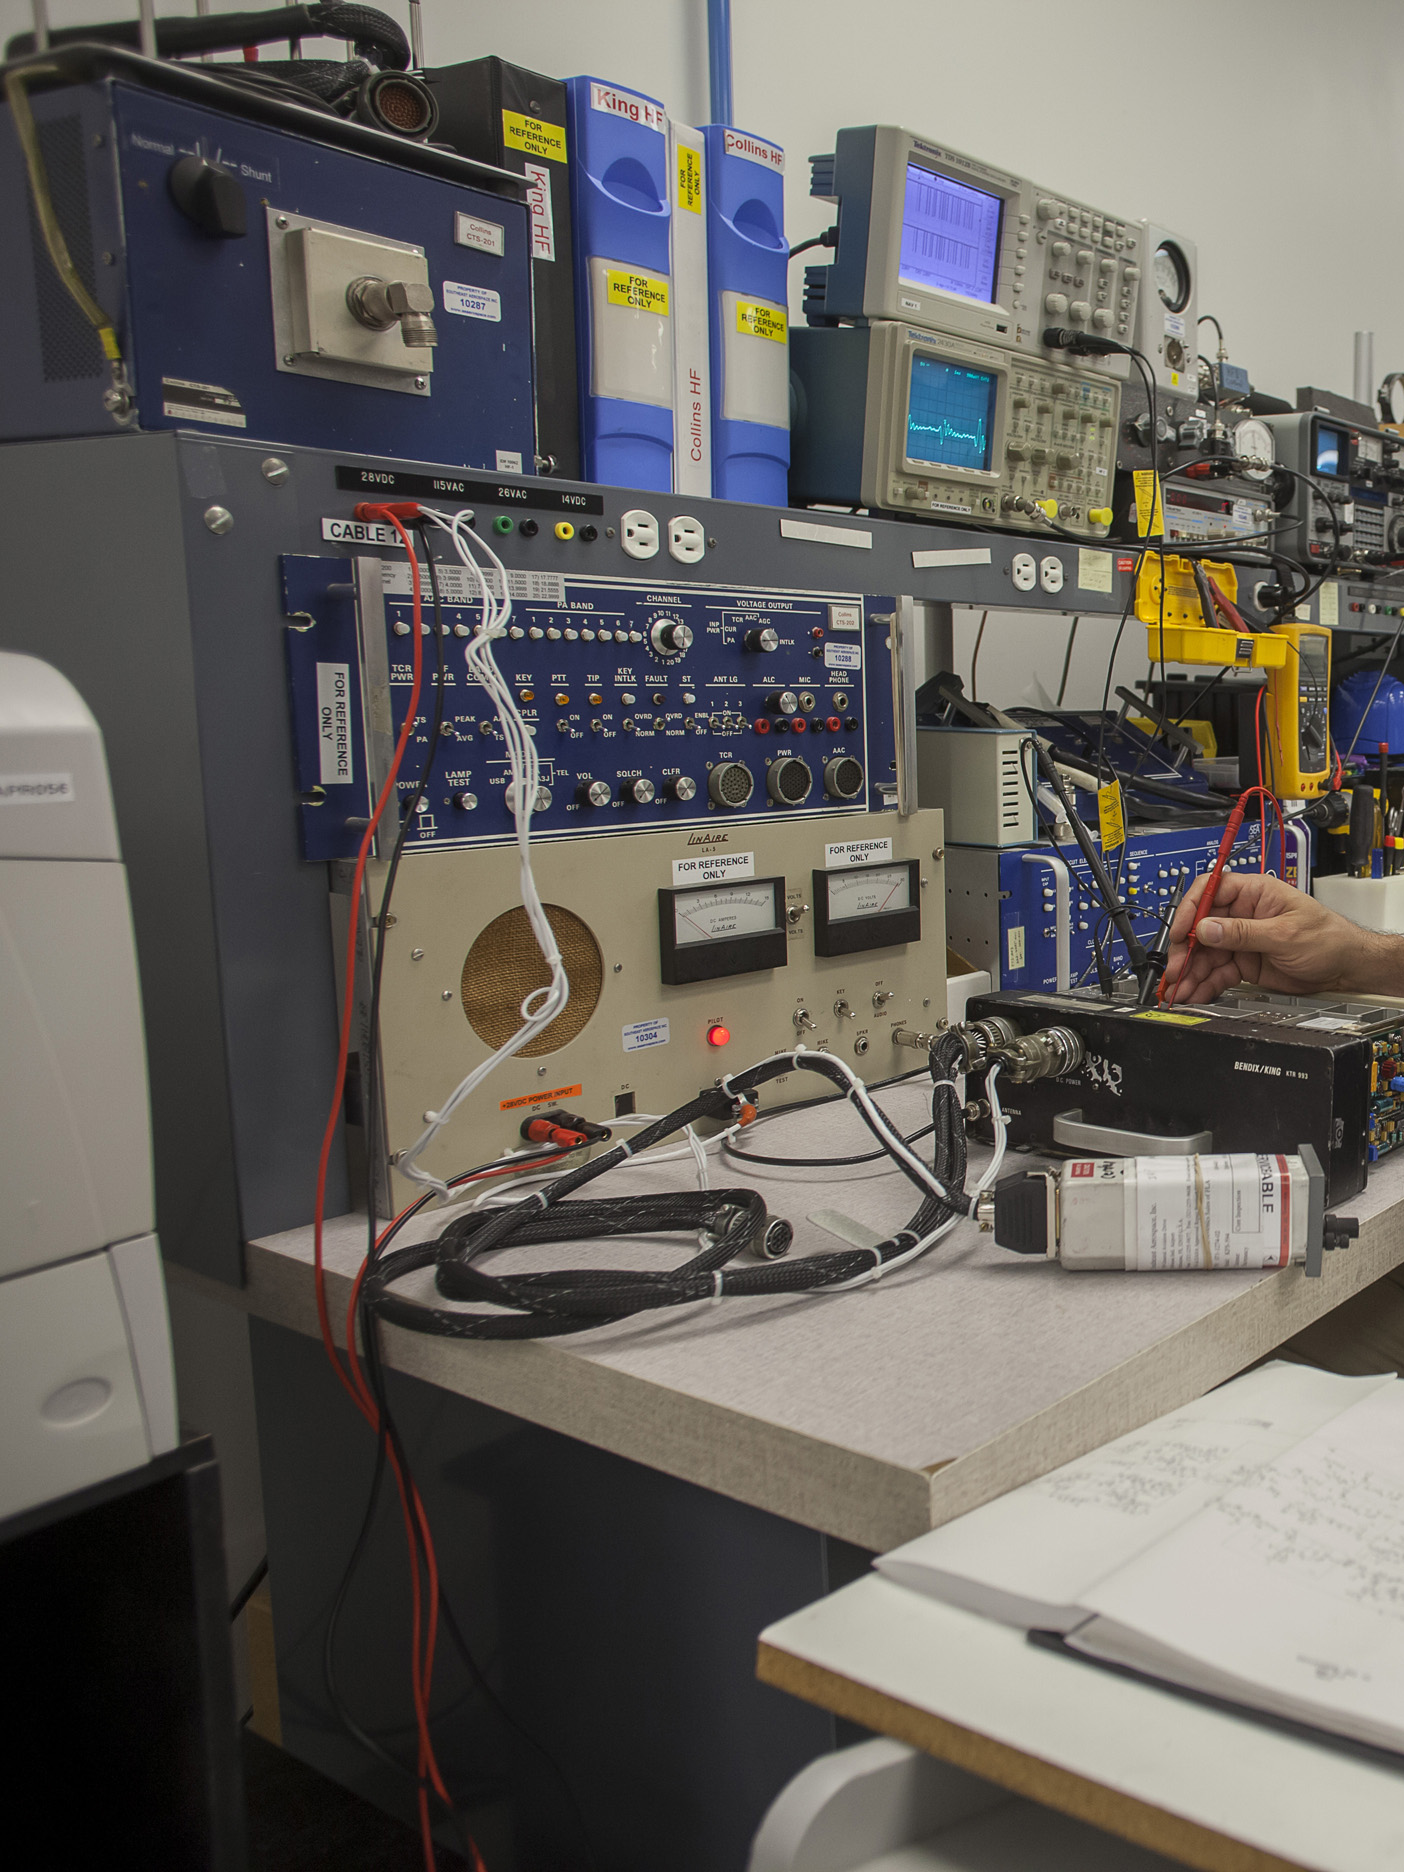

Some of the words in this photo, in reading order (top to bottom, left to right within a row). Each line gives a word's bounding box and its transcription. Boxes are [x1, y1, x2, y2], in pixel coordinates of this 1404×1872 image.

[597, 89, 639, 121] King
[645, 105, 663, 125] HF
[524, 120, 542, 132] FOR
[132, 132, 175, 156] Normal
[509, 126, 562, 149] REFERENCE
[524, 142, 548, 155] ONLY
[726, 134, 768, 159] Collins
[770, 150, 783, 166] HF
[913, 140, 941, 157] Tektronix
[241, 164, 272, 183] Shunt
[529, 170, 547, 216] King
[470, 224, 492, 236] Collins
[466, 233, 495, 246] CTS-201
[534, 223, 550, 255] HF
[629, 276, 648, 288] FOR
[457, 286, 480, 294] PROPERTY
[614, 282, 666, 303] REFERENCE
[460, 299, 486, 310] 10287
[627, 296, 652, 308] ONLY
[755, 307, 770, 318] FOR
[742, 314, 784, 332] REFERENCE
[754, 324, 774, 337] ONLY
[908, 330, 936, 344] Tektronix
[690, 368, 701, 395] HF
[690, 402, 702, 462] Collins
[361, 472, 395, 485] 28VDC
[434, 480, 465, 493] 115VAC
[498, 488, 528, 500] 26VAC
[562, 494, 587, 506] 14VDC
[330, 522, 386, 542] CABLE
[557, 601, 568, 609] PA
[570, 602, 594, 610] BAND
[647, 595, 682, 604] CHANNEL
[737, 600, 766, 608] VOLTAGE
[768, 602, 793, 610] OUTPUT
[392, 664, 412, 672] TCR
[391, 673, 414, 681] PWR
[515, 674, 532, 682] KEY
[552, 674, 566, 682] PTT
[334, 672, 345, 698] FOR
[321, 706, 333, 741] ONLY
[415, 716, 427, 724] TS
[335, 701, 348, 776] REFERENCE
[576, 772, 593, 780] VOL
[829, 845, 845, 855] FOR
[846, 841, 888, 852] REFERENCE
[678, 862, 697, 872] FOR
[698, 856, 749, 869] REFERENCE
[850, 853, 870, 862] ONLY
[703, 870, 726, 880] ONLY
[890, 1020, 907, 1028] PHONES
[636, 1032, 658, 1042] 10304
[1234, 1062, 1282, 1076] BENDIX/KING
[1286, 1070, 1297, 1078] KTR
[1066, 1078, 1082, 1086] POWER
[502, 1098, 527, 1109] +28VDC
[528, 1092, 553, 1102] POWER
[554, 1088, 573, 1098] INPUT
[1002, 1107, 1022, 1116] ANTENNA
